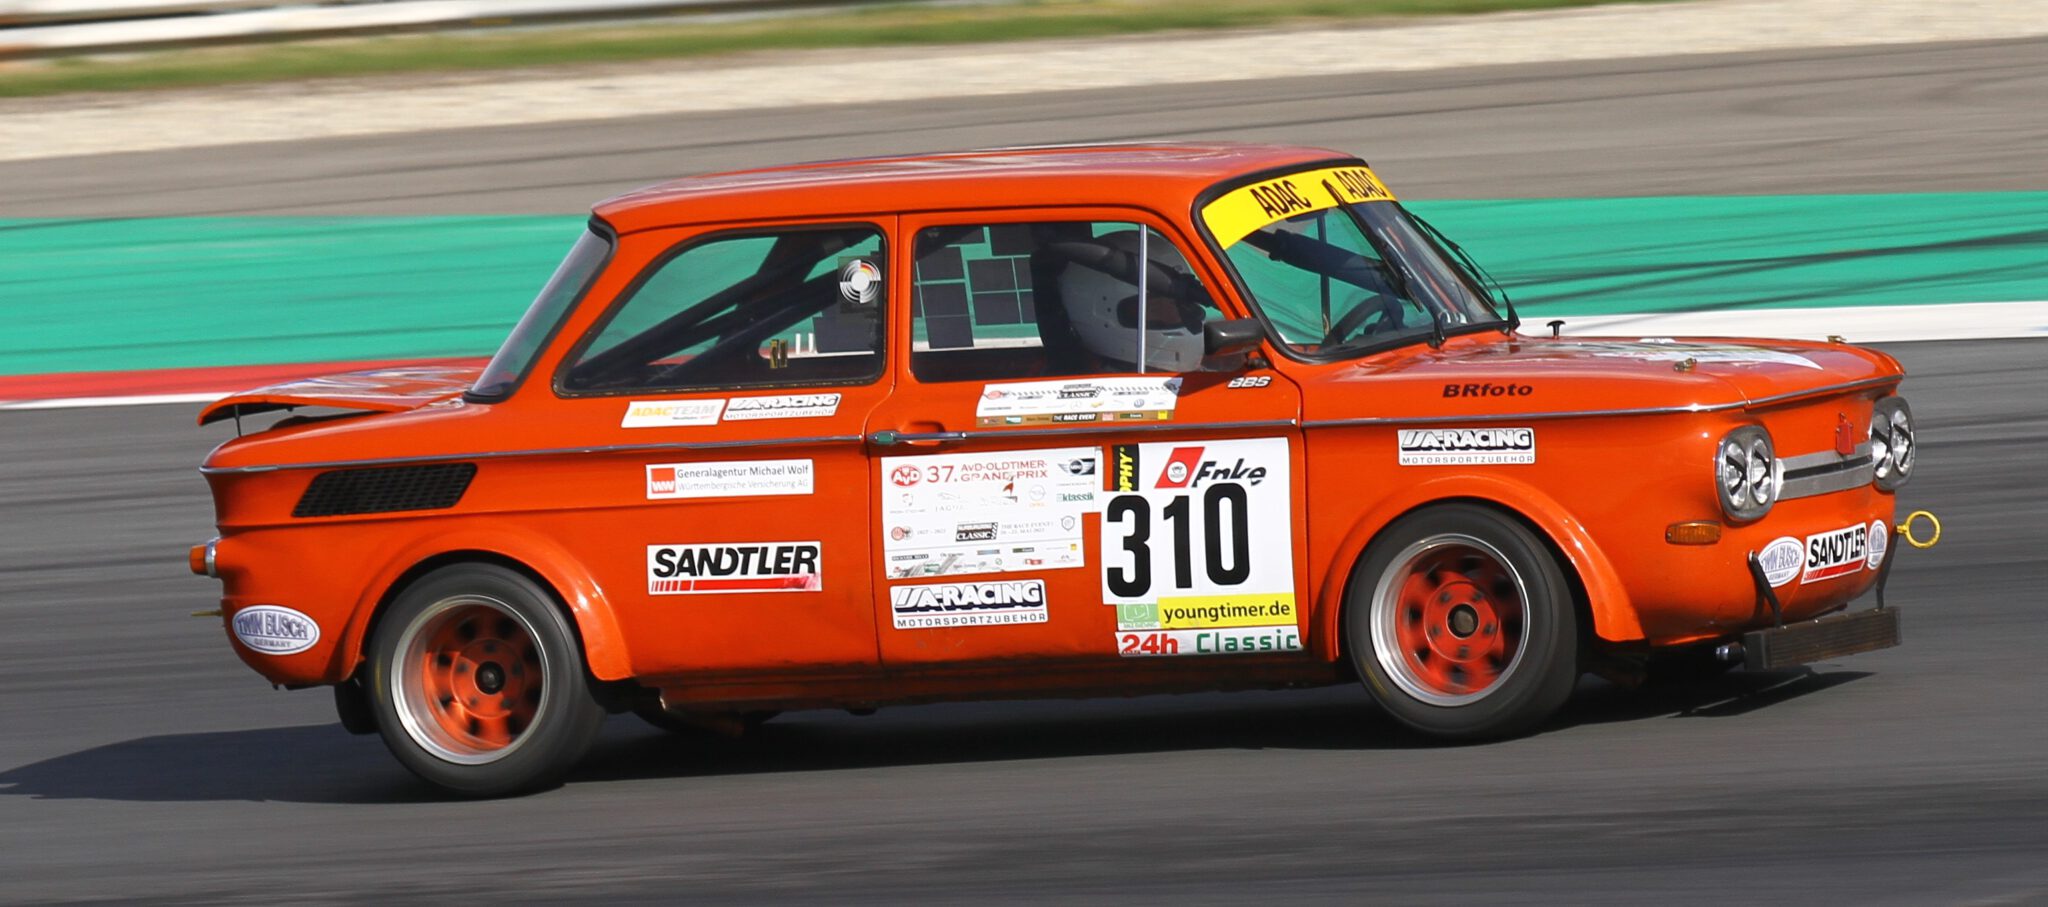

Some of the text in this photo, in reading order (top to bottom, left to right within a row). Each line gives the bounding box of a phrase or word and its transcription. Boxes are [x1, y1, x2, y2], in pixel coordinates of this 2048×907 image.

[1333, 170, 1388, 199] ADAC
[1250, 180, 1312, 218] ADAC
[1227, 376, 1273, 389] BBS
[1442, 383, 1533, 398] BRfoto
[676, 464, 809, 479] Generalagentur Michael Wolf
[927, 465, 958, 483] 37.
[1107, 482, 1250, 599] 310
[1808, 527, 1866, 568] SANDTLER
[653, 545, 818, 578] SANDTLER
[1164, 601, 1290, 622] youngtimer.de
[265, 612, 308, 638] BUSCH
[1122, 629, 1297, 654] 24h Classic
